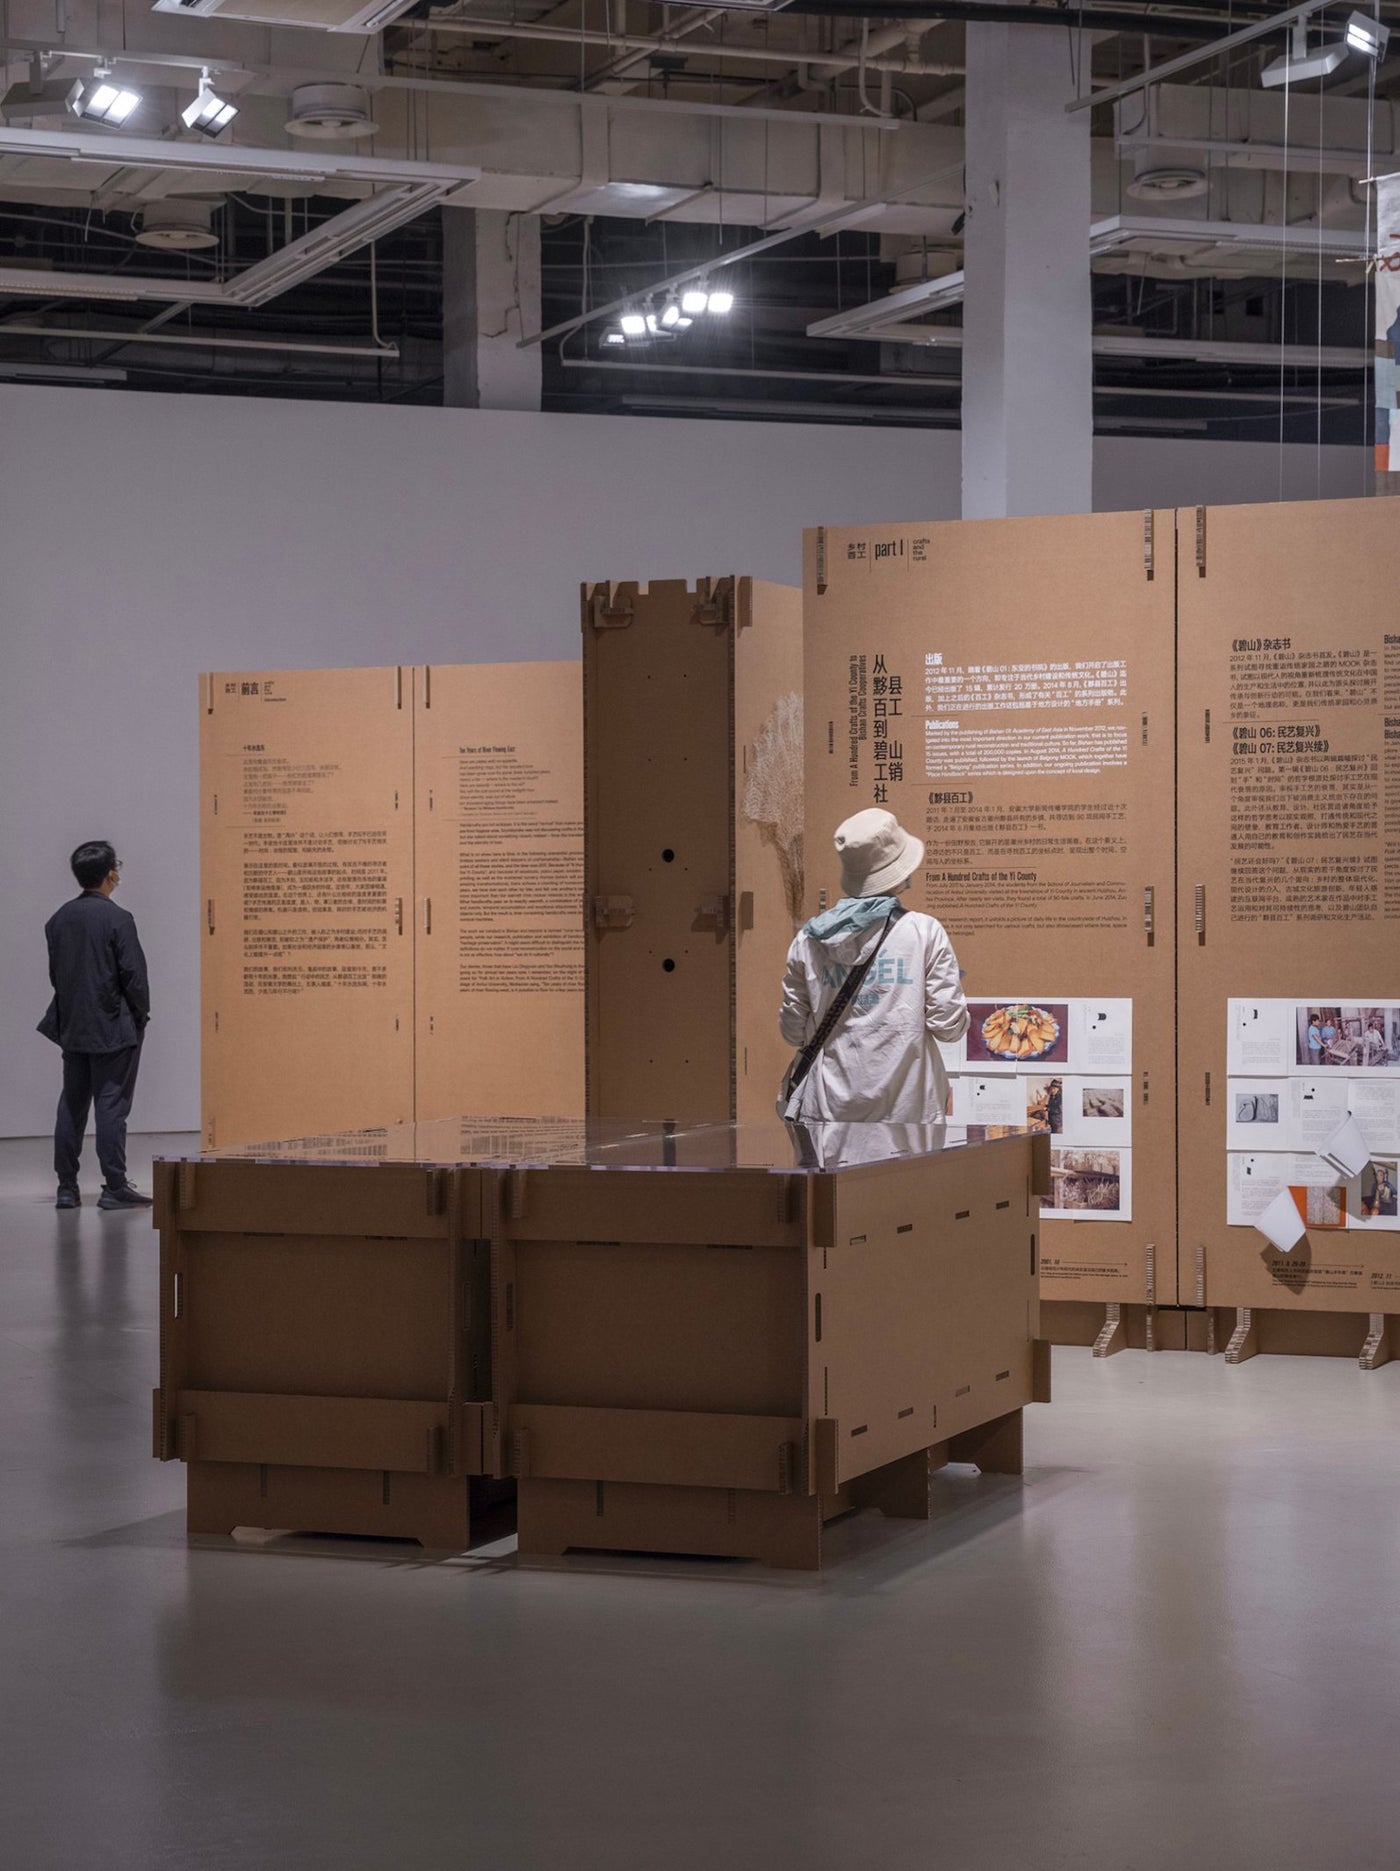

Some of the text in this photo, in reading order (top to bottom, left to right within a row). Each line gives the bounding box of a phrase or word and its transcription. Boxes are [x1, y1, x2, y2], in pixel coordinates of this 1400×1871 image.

[875, 540, 896, 560] part
[1232, 638, 1291, 652] 《碧山》杂志书
[926, 653, 942, 664] 出版
[849, 663, 858, 684] County
[849, 695, 858, 706] the
[849, 715, 858, 735] Crafts
[925, 720, 959, 729] Publications
[1233, 725, 1320, 739] 《碧山 06: 民艺复兴》
[849, 736, 858, 762] Hundred
[1233, 740, 1329, 755] 《碧山 07: 民艺复兴续》
[849, 770, 858, 787] From
[928, 792, 974, 804] 《黟县百工》
[926, 872, 1036, 882] From A Hundred Crafts of the Yi County
